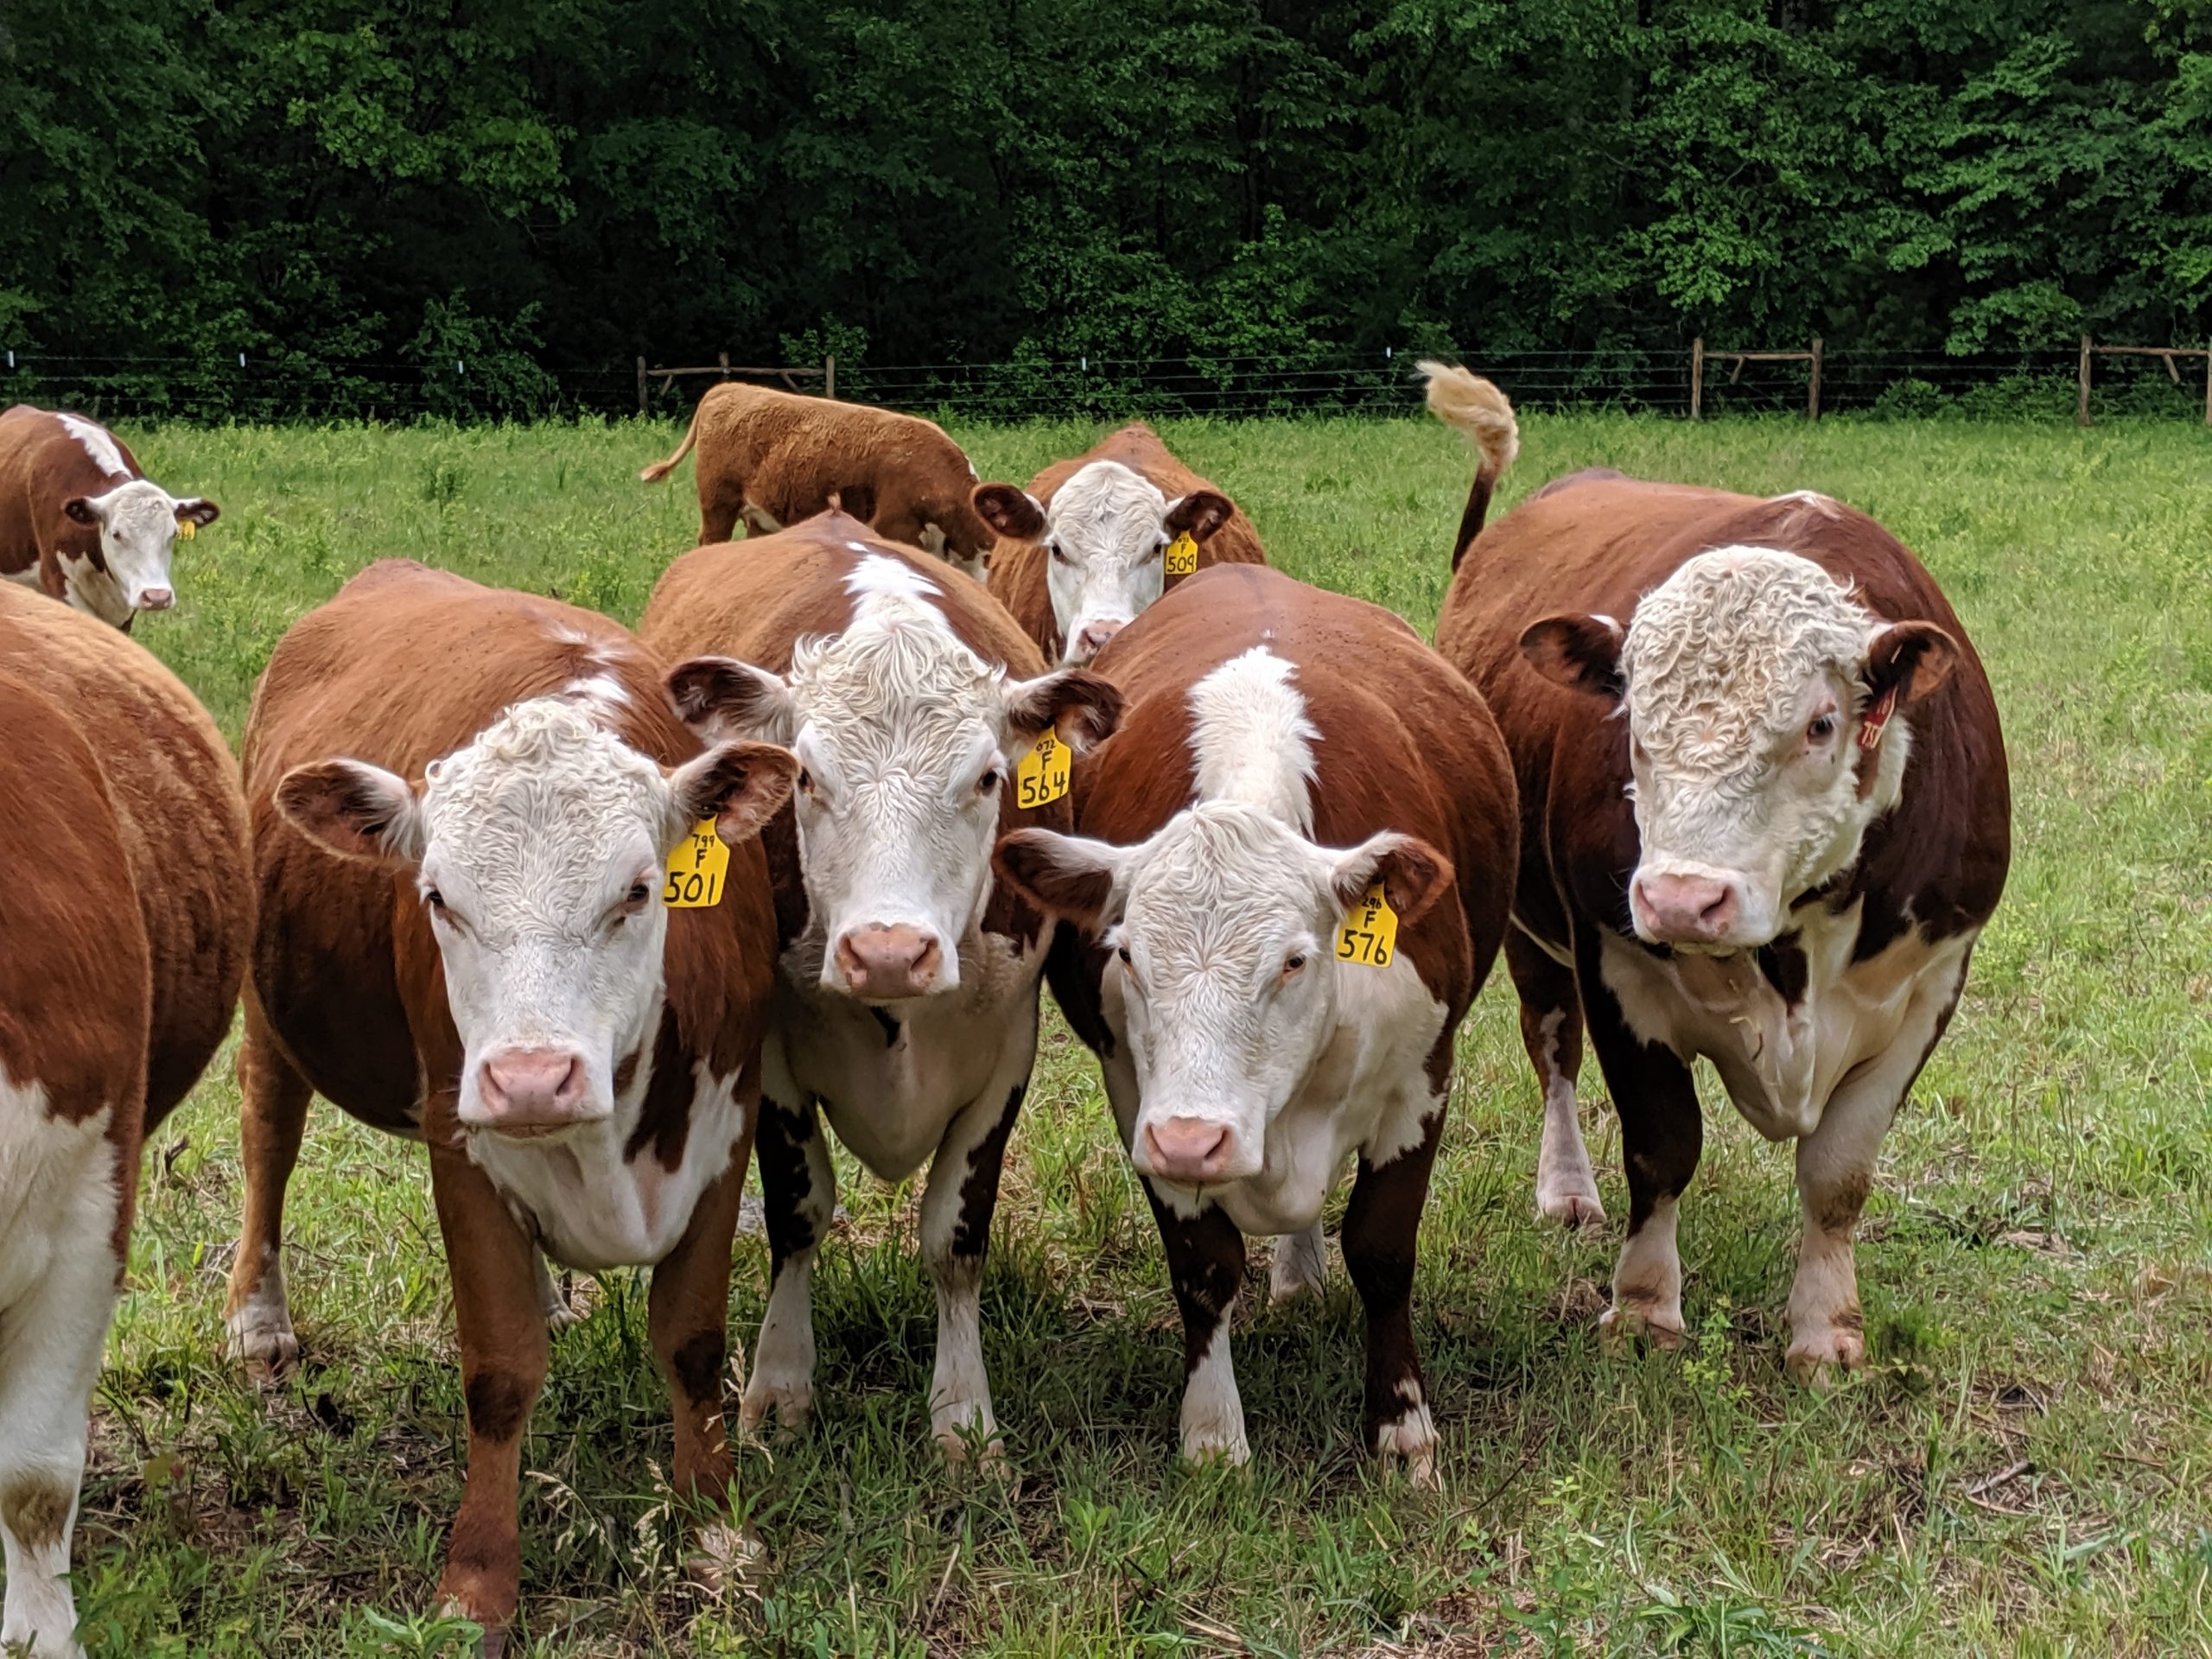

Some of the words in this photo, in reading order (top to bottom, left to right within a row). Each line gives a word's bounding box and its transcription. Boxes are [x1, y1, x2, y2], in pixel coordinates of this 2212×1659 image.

[1180, 543, 1187, 554] F
[1167, 554, 1195, 573] 509
[1036, 739, 1056, 752] 072
[1041, 750, 1052, 771] F
[1021, 771, 1066, 804] 564
[692, 834, 715, 848] 799
[696, 849, 708, 868] F
[664, 871, 715, 905] 501
[1364, 910, 1377, 928] F
[1338, 928, 1388, 965] 576
